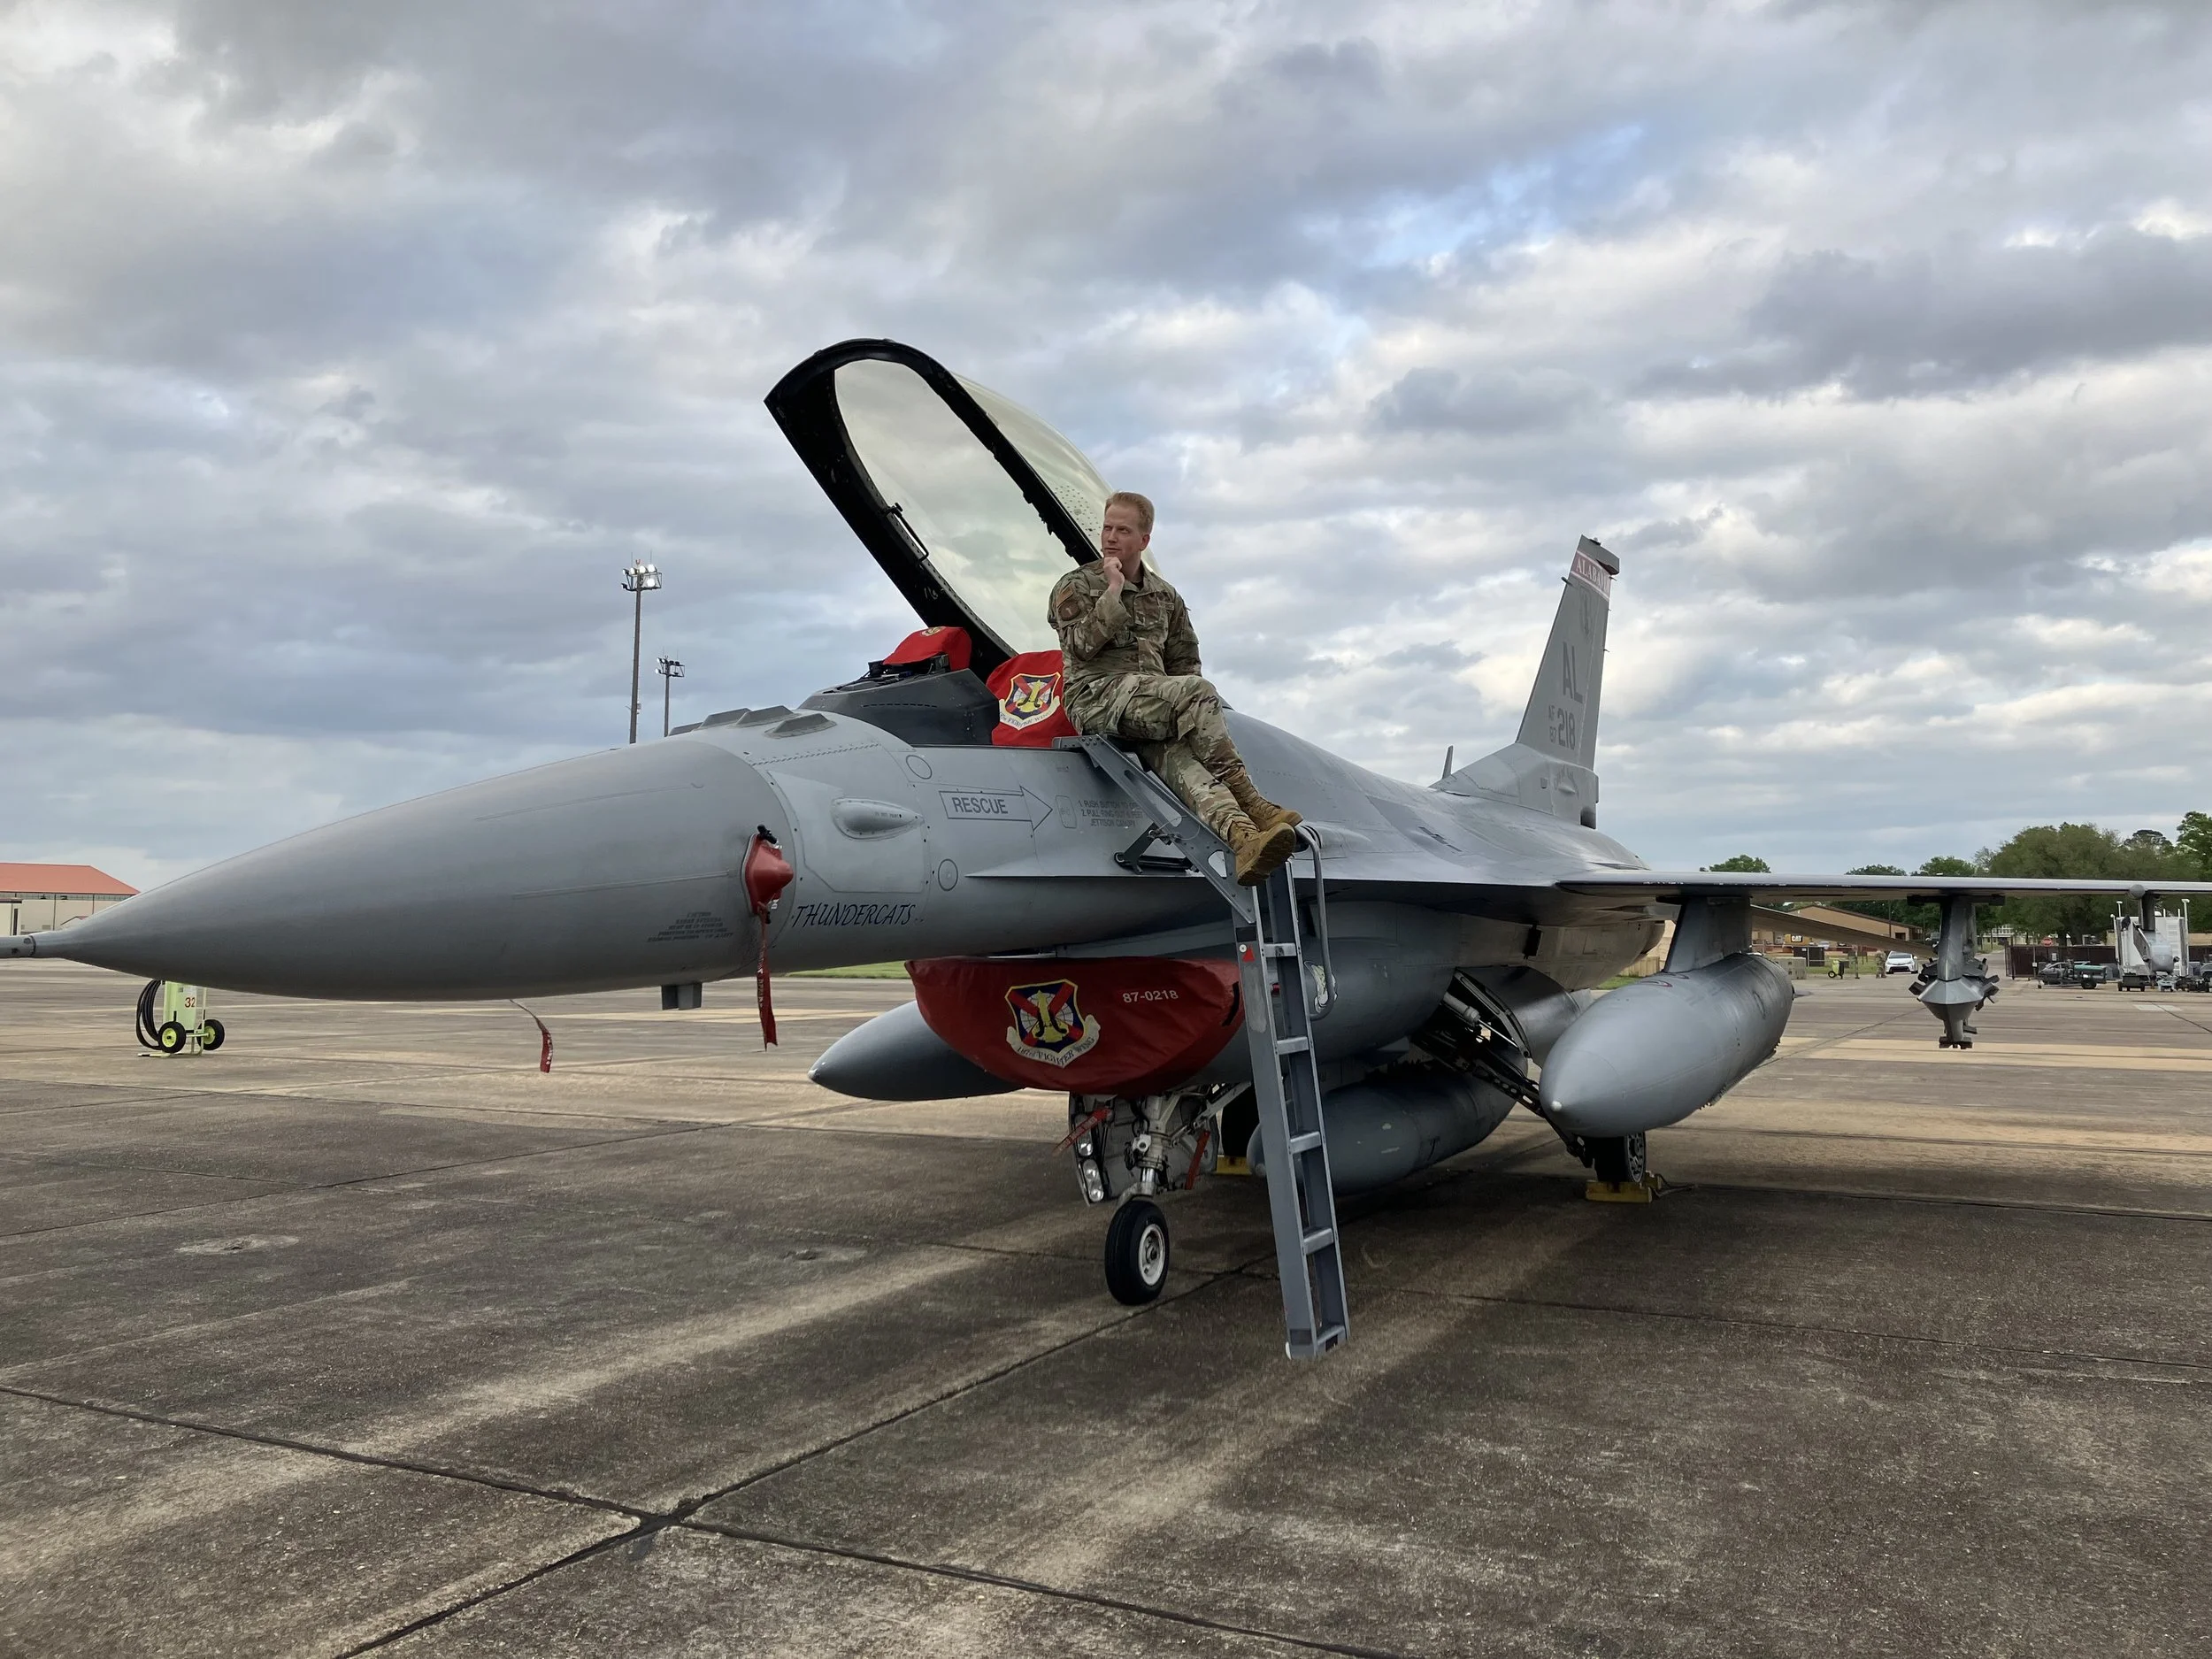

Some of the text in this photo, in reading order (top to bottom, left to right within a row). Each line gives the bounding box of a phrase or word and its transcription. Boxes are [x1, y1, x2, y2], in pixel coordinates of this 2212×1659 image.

[1563, 641, 1583, 704] AL
[1557, 707, 1576, 750] 218
[951, 796, 1009, 815] RESCUE
[792, 902, 916, 927] THUNDERCATS
[184, 996, 196, 1008] 32
[1123, 990, 1179, 1002] 87-0218
[1037, 1049, 1074, 1066] FIGHTER
